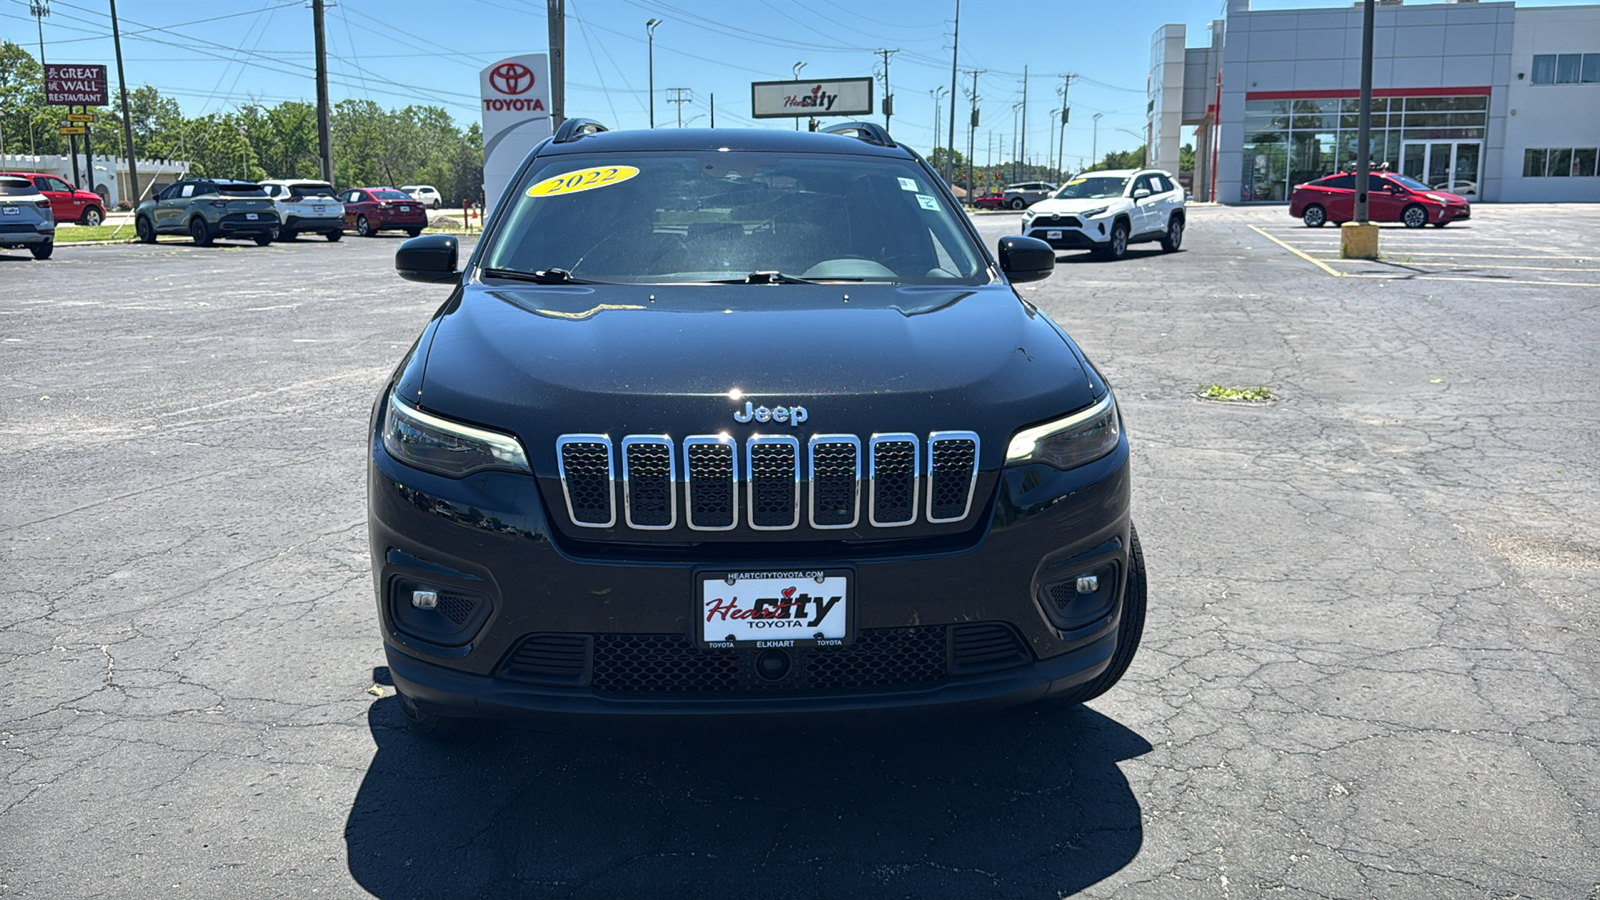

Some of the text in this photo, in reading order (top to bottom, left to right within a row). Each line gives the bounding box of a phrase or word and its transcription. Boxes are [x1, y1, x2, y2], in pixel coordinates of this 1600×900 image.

[60, 68, 99, 79] GREAT
[61, 80, 99, 92] WALL
[48, 93, 102, 102] RESTAURANT
[483, 98, 545, 111] TOYOTA
[547, 168, 618, 193] 2022
[734, 401, 808, 426] Jeep
[728, 571, 824, 580] HEARTCITYTOYOTA.COM
[706, 592, 842, 627] Heart city
[747, 620, 802, 628] TOYOTA
[756, 640, 794, 648] ELKHART
